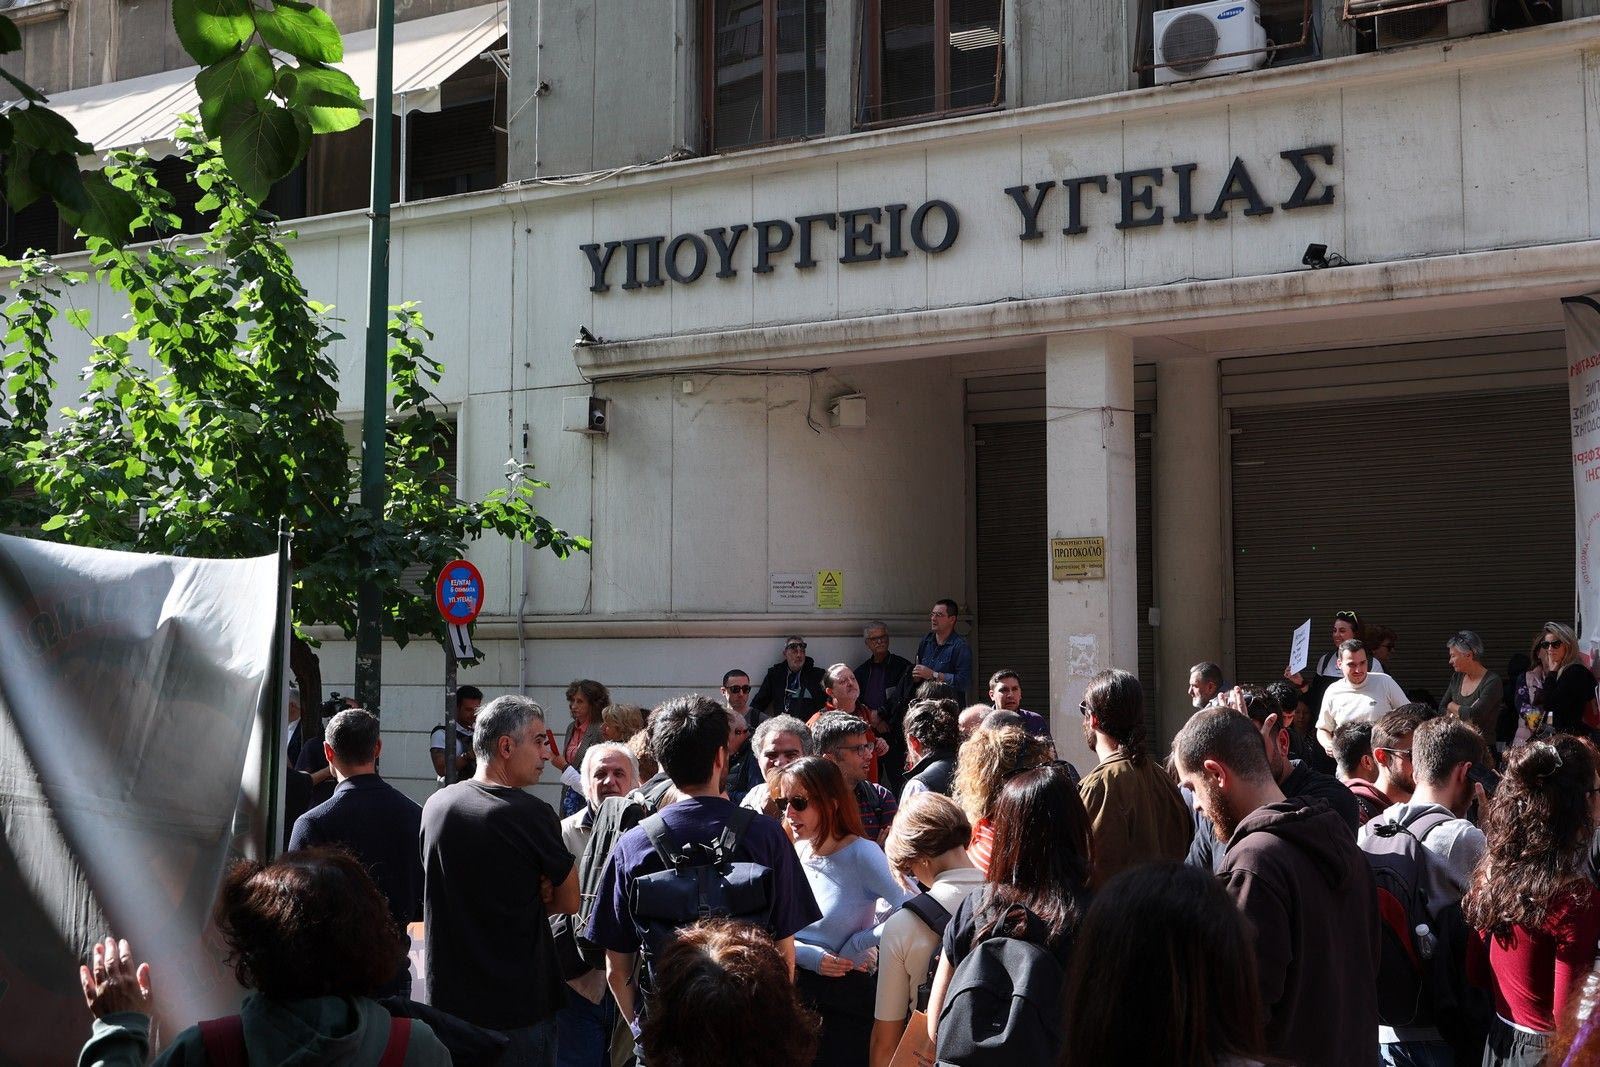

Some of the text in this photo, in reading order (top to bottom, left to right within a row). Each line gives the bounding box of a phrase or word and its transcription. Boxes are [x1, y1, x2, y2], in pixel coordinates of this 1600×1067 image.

[579, 144, 1335, 292] ΥΠΟΥΡΓΕΙΟ ΥΓΕΙΑΣ
[1055, 547, 1102, 557] ΠΡΩΤΟΚΟΛΛΟ
